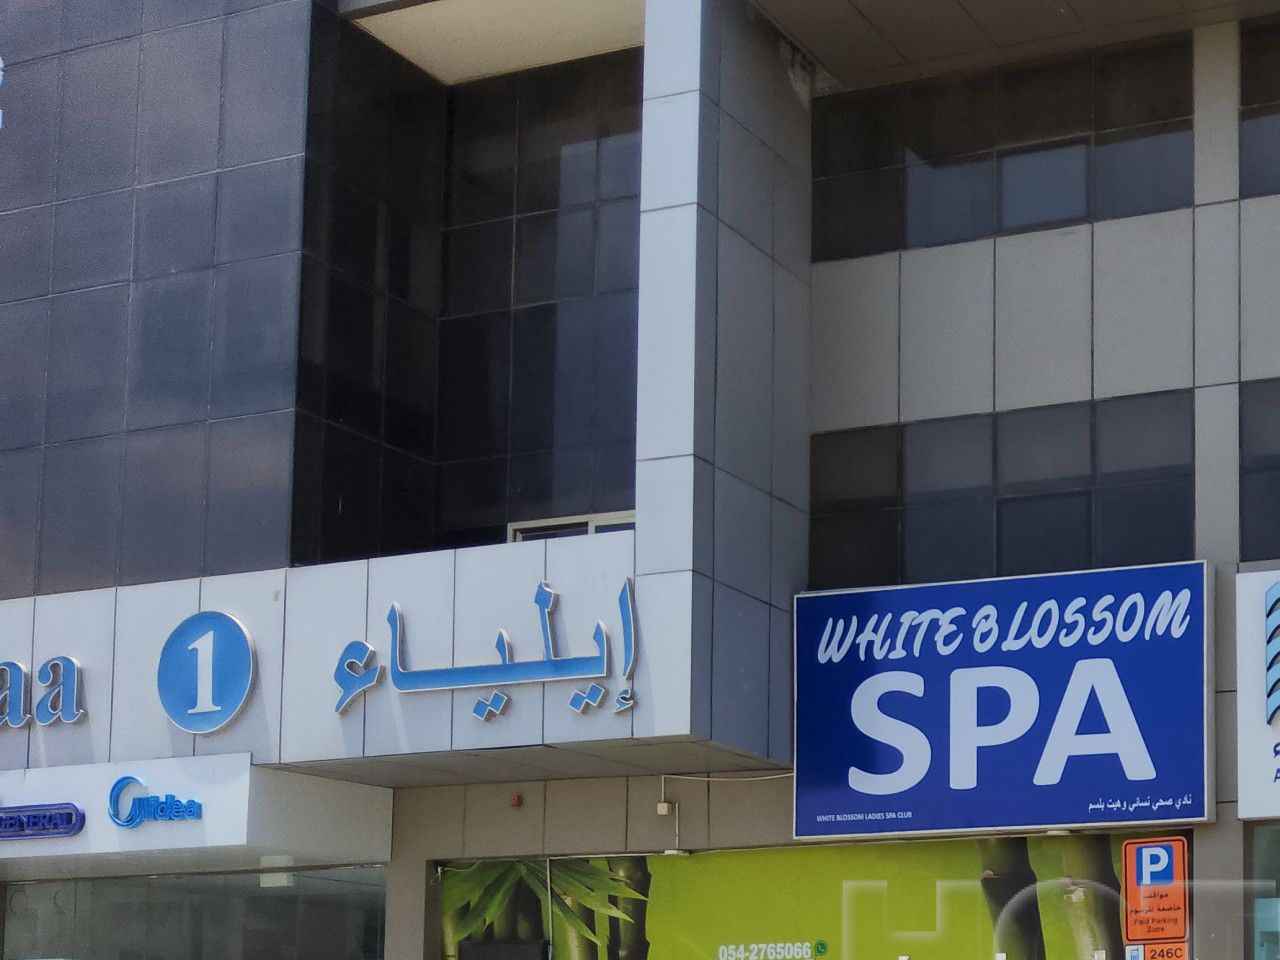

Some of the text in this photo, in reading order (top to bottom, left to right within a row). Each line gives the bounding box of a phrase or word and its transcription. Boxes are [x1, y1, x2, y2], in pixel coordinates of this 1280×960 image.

[817, 606, 967, 664] WHITE
[186, 630, 222, 715] 1
[848, 658, 1158, 796] SPA
[816, 811, 912, 823] WHITE BLOSSOM LADIES SPA CLUB
[1152, 798, 1173, 811] صحي
[1142, 847, 1169, 885] P
[1134, 917, 1178, 926] Paid Parking
[1150, 947, 1183, 960] 246C
